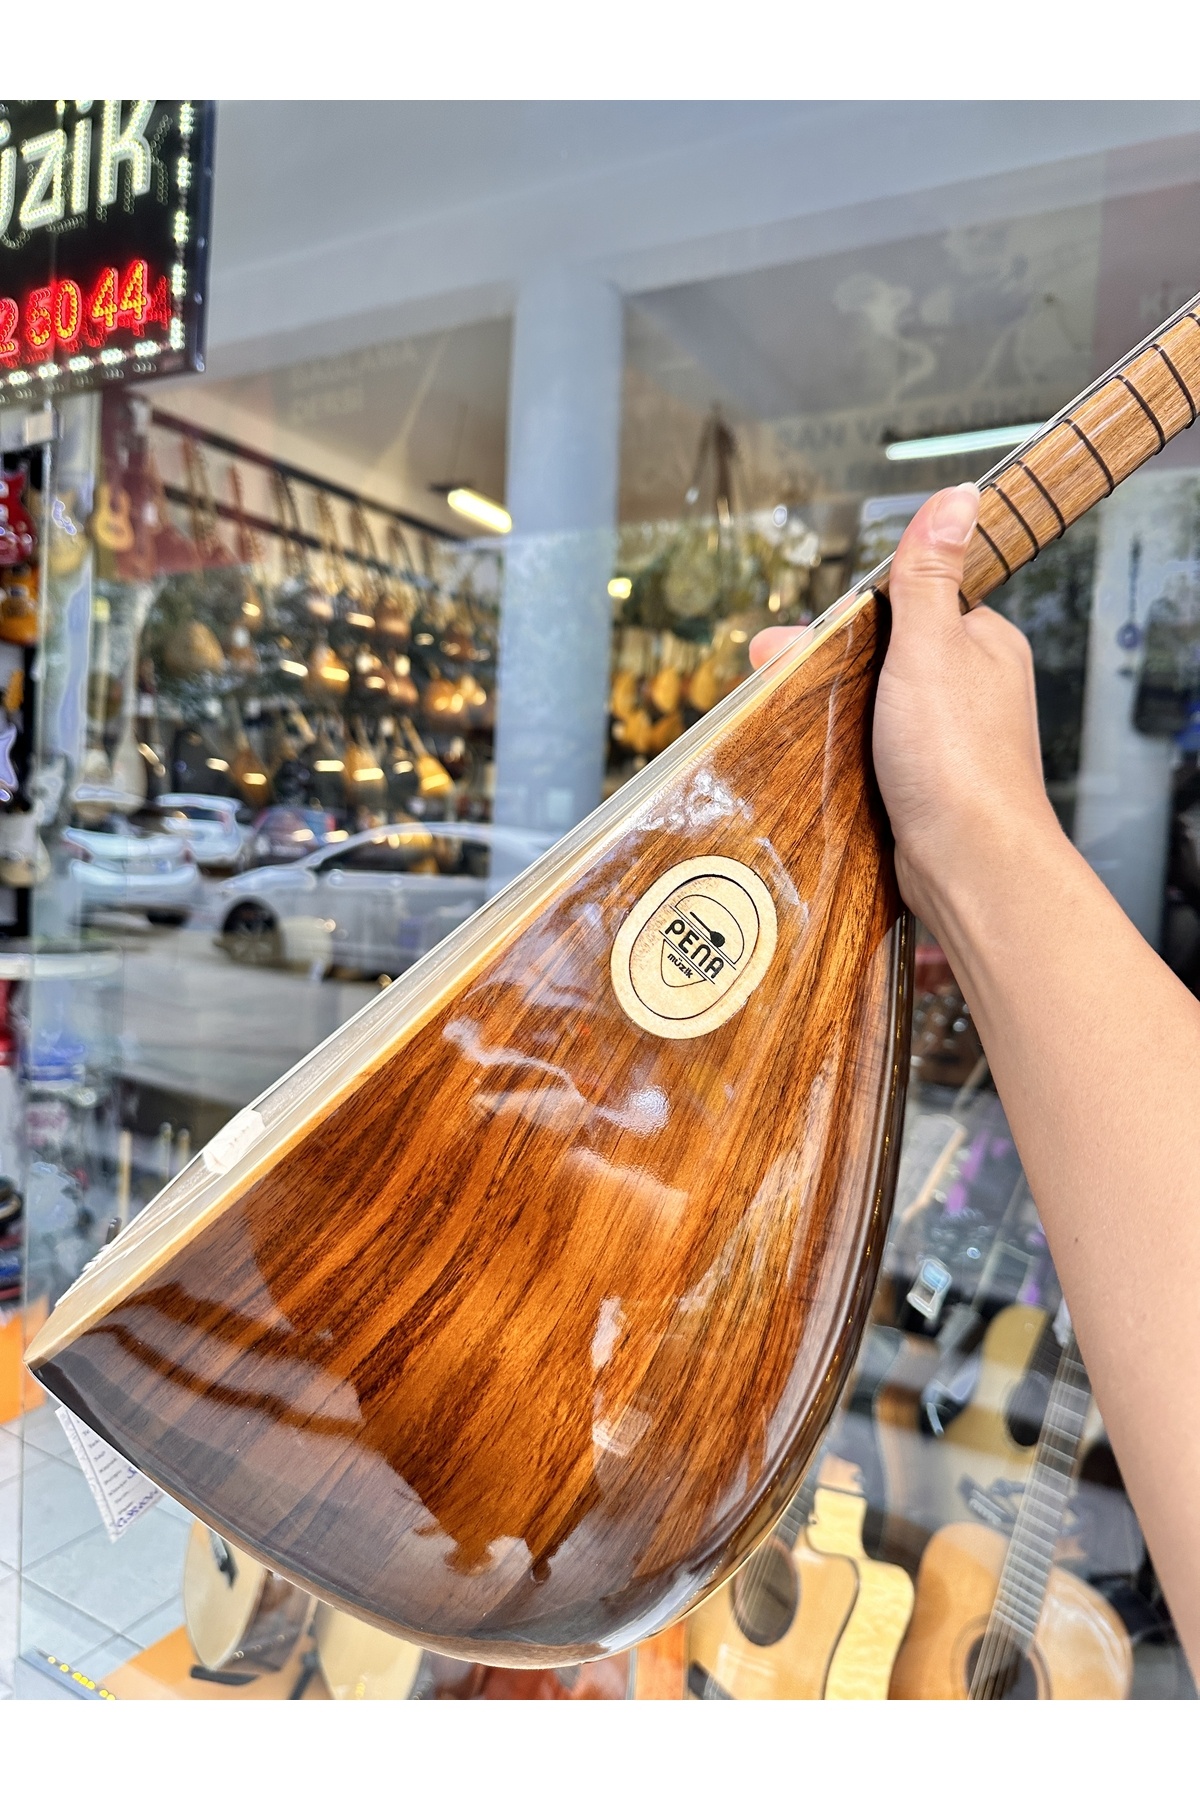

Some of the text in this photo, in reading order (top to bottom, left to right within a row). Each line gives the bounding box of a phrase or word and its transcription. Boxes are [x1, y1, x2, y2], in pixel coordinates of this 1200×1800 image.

[27, 279, 82, 349] 50
[90, 260, 149, 331] 44
[664, 919, 725, 979] PENA
[667, 953, 694, 979] müzik
